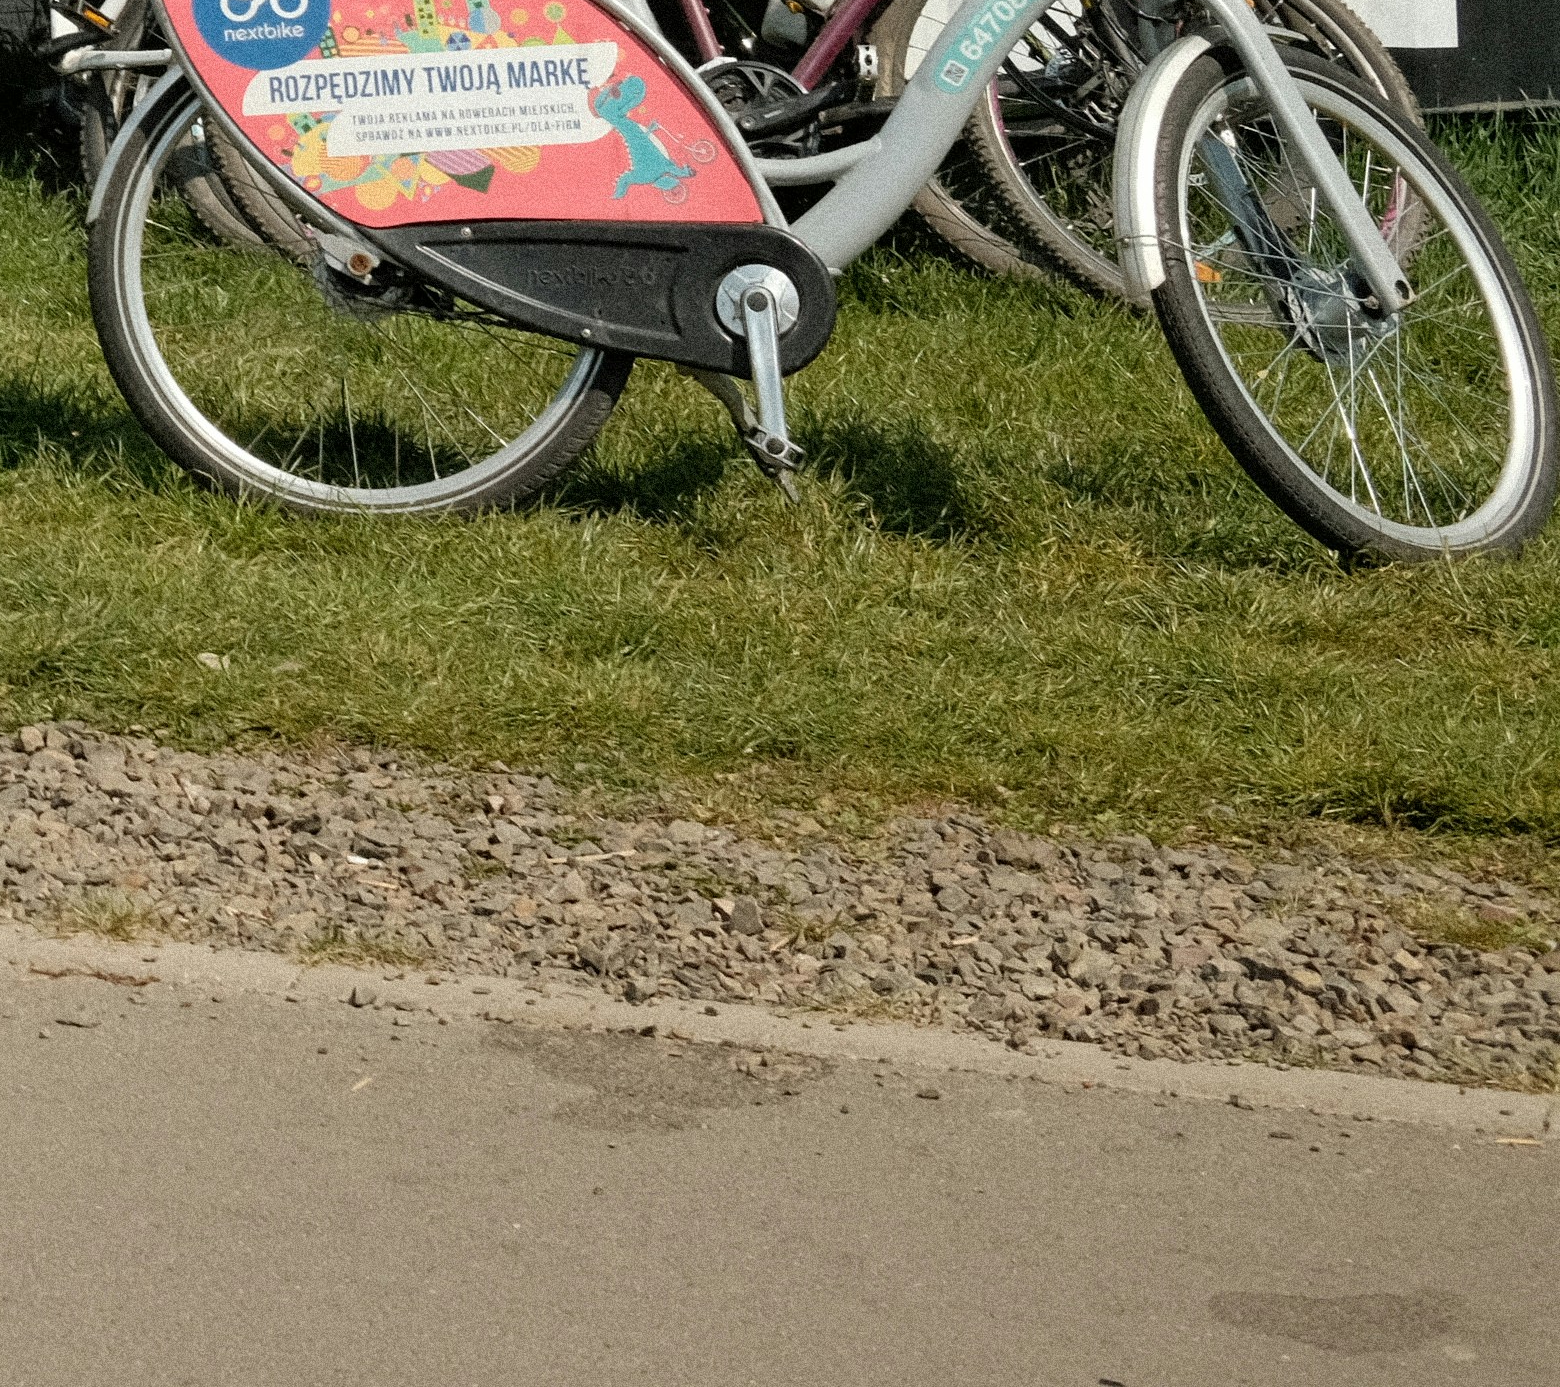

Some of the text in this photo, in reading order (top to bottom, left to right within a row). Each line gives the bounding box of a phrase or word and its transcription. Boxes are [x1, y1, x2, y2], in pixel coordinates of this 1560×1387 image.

[224, 22, 305, 42] nextbike
[269, 58, 592, 104] ROZPĘDZIMY TWOJĄ MARKĘ
[352, 114, 385, 126] TWOJA
[389, 110, 438, 124] REKLAMA
[441, 110, 456, 120] NA
[459, 106, 516, 119] ROWERACH
[407, 127, 422, 138] NA
